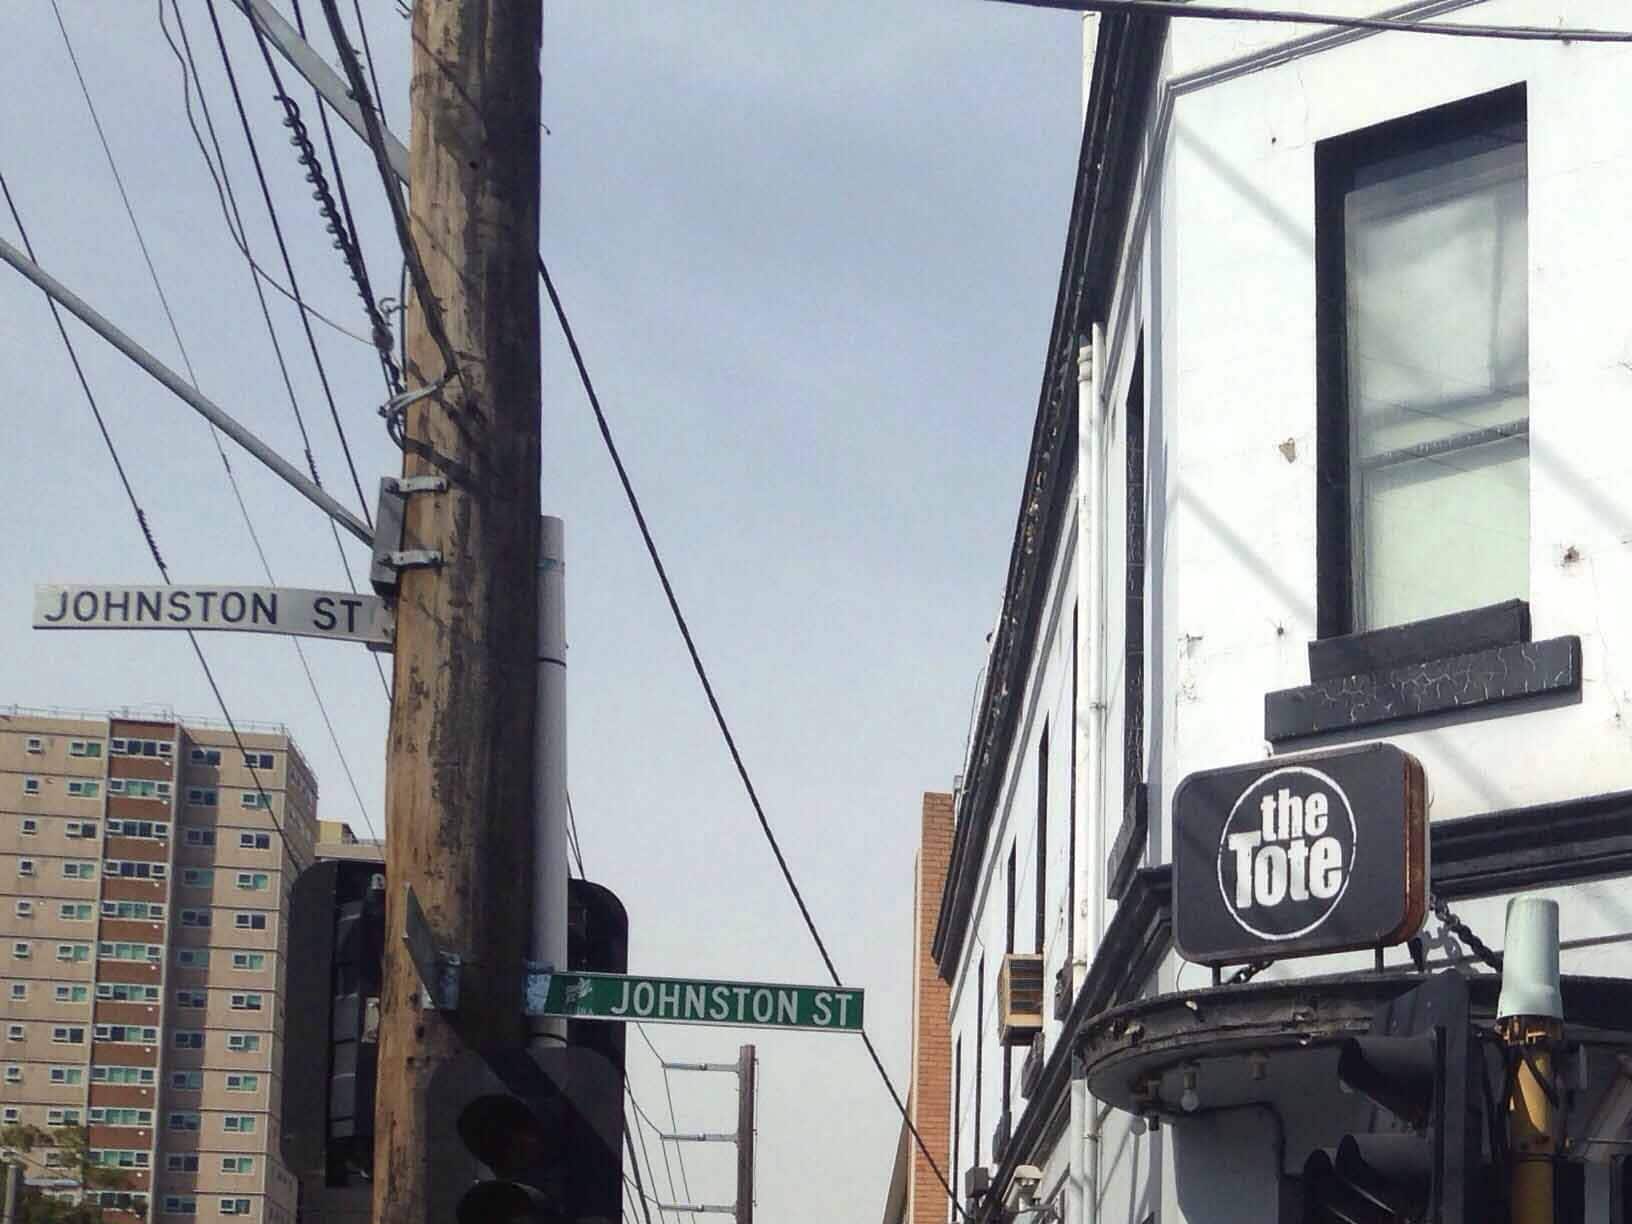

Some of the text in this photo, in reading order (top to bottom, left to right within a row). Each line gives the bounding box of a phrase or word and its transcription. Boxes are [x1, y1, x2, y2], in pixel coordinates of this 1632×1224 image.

[43, 590, 363, 633] JOHNSTON ST
[1260, 787, 1329, 842] the
[1227, 829, 1343, 910] Tote
[609, 980, 854, 1027] JOHNSTON ST
